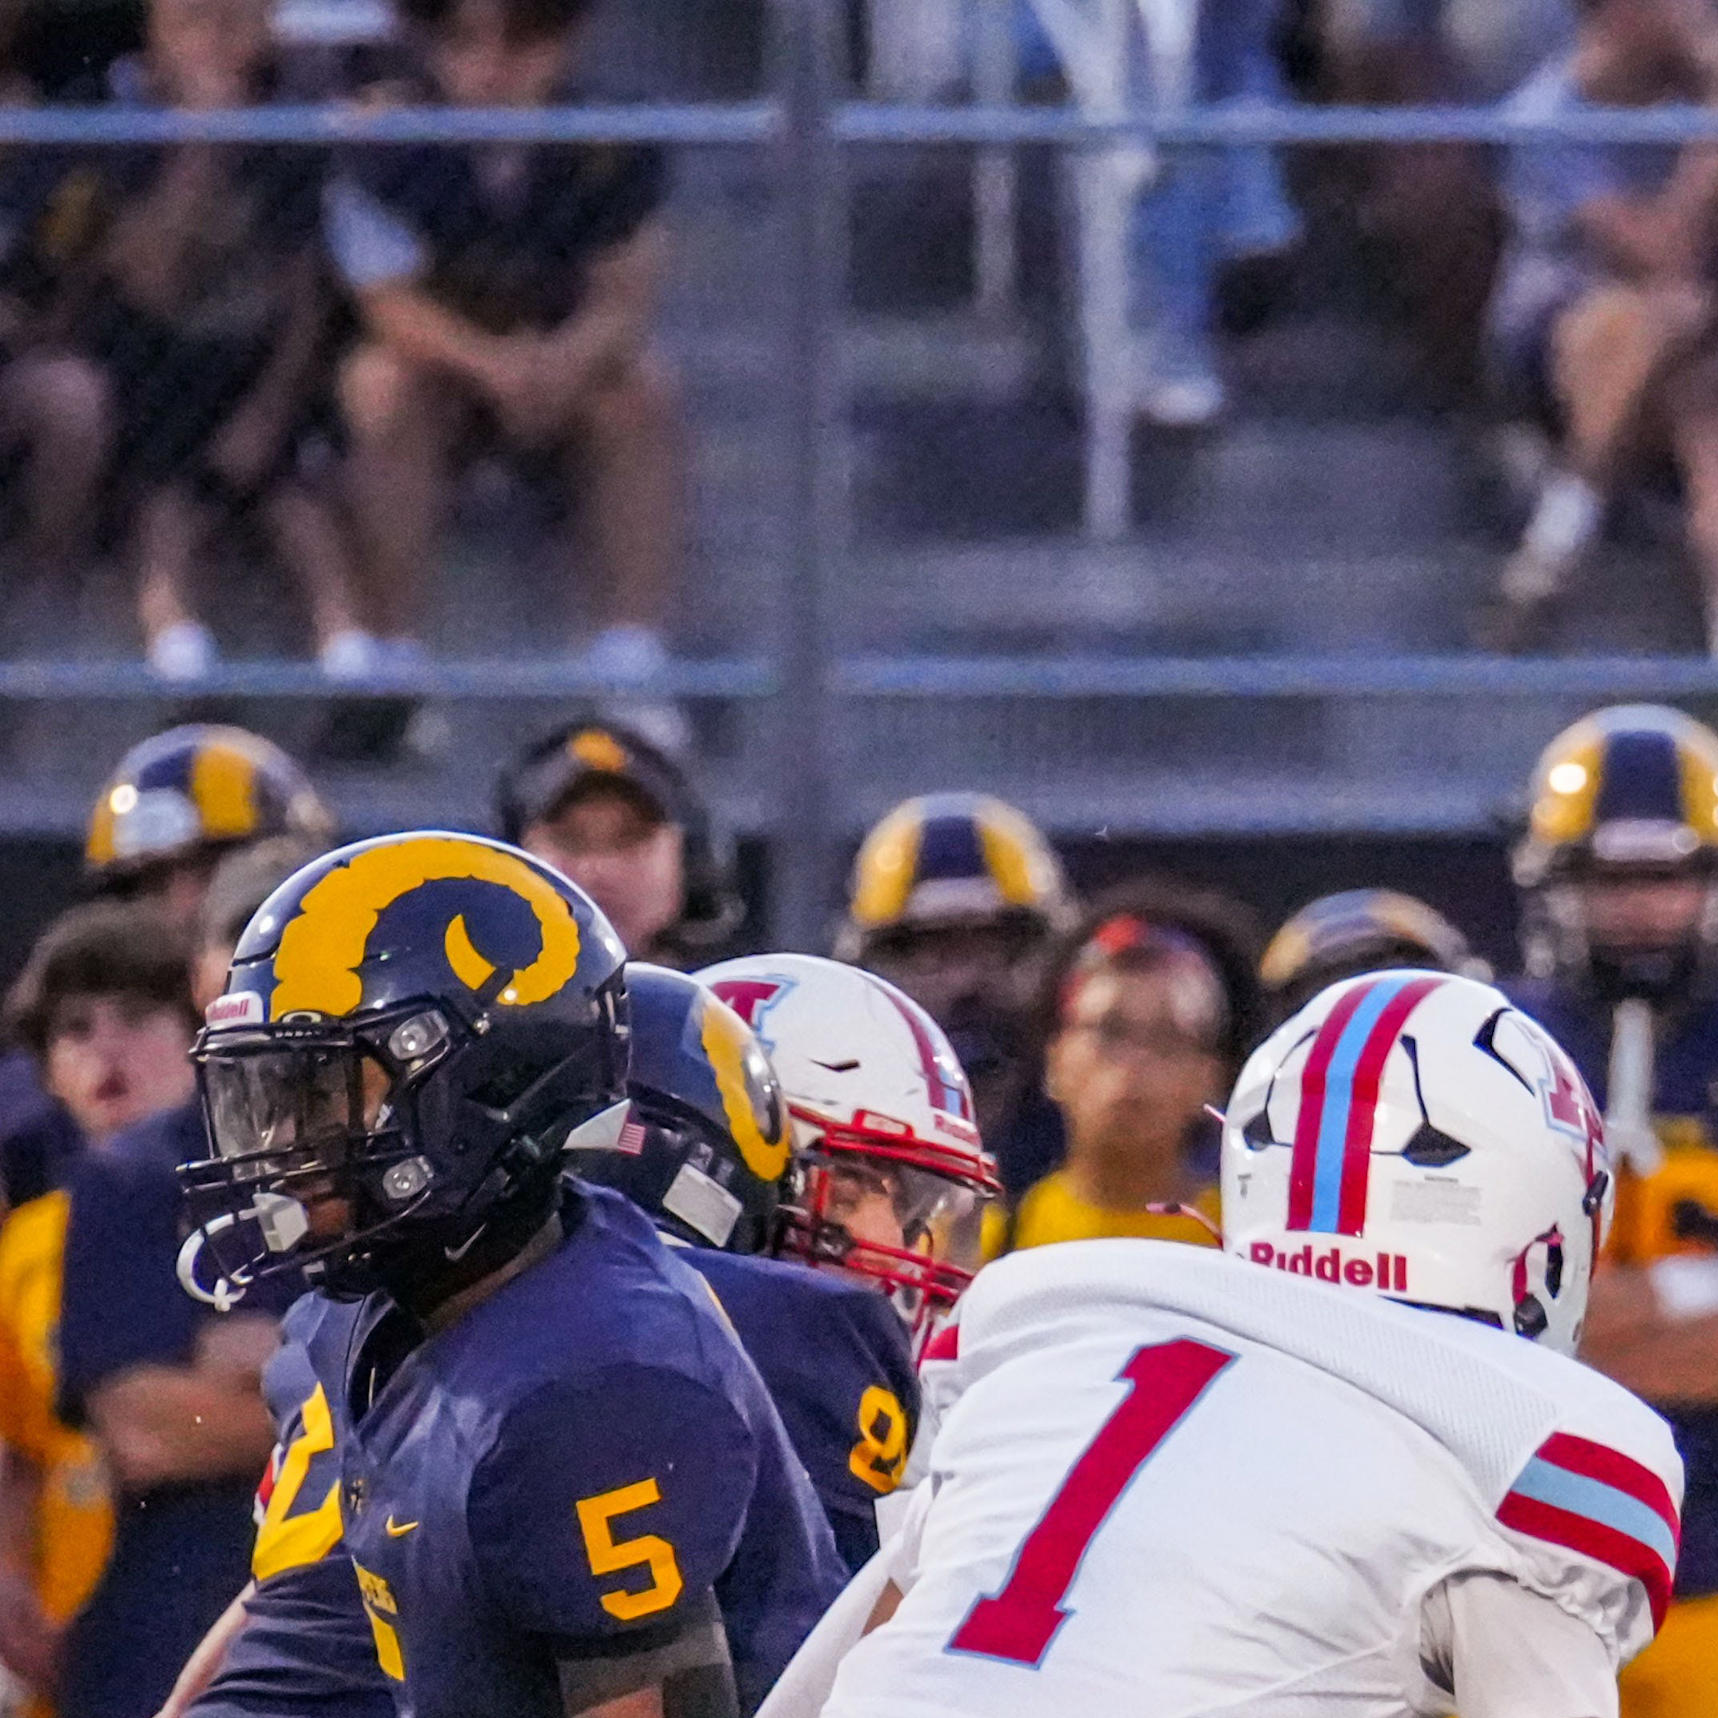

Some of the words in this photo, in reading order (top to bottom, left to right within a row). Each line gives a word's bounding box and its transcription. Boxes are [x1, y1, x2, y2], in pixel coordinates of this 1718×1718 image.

[1249, 1241, 1407, 1293] Riddell
[575, 1476, 684, 1621] 5
[943, 1334, 1242, 1672] 1
